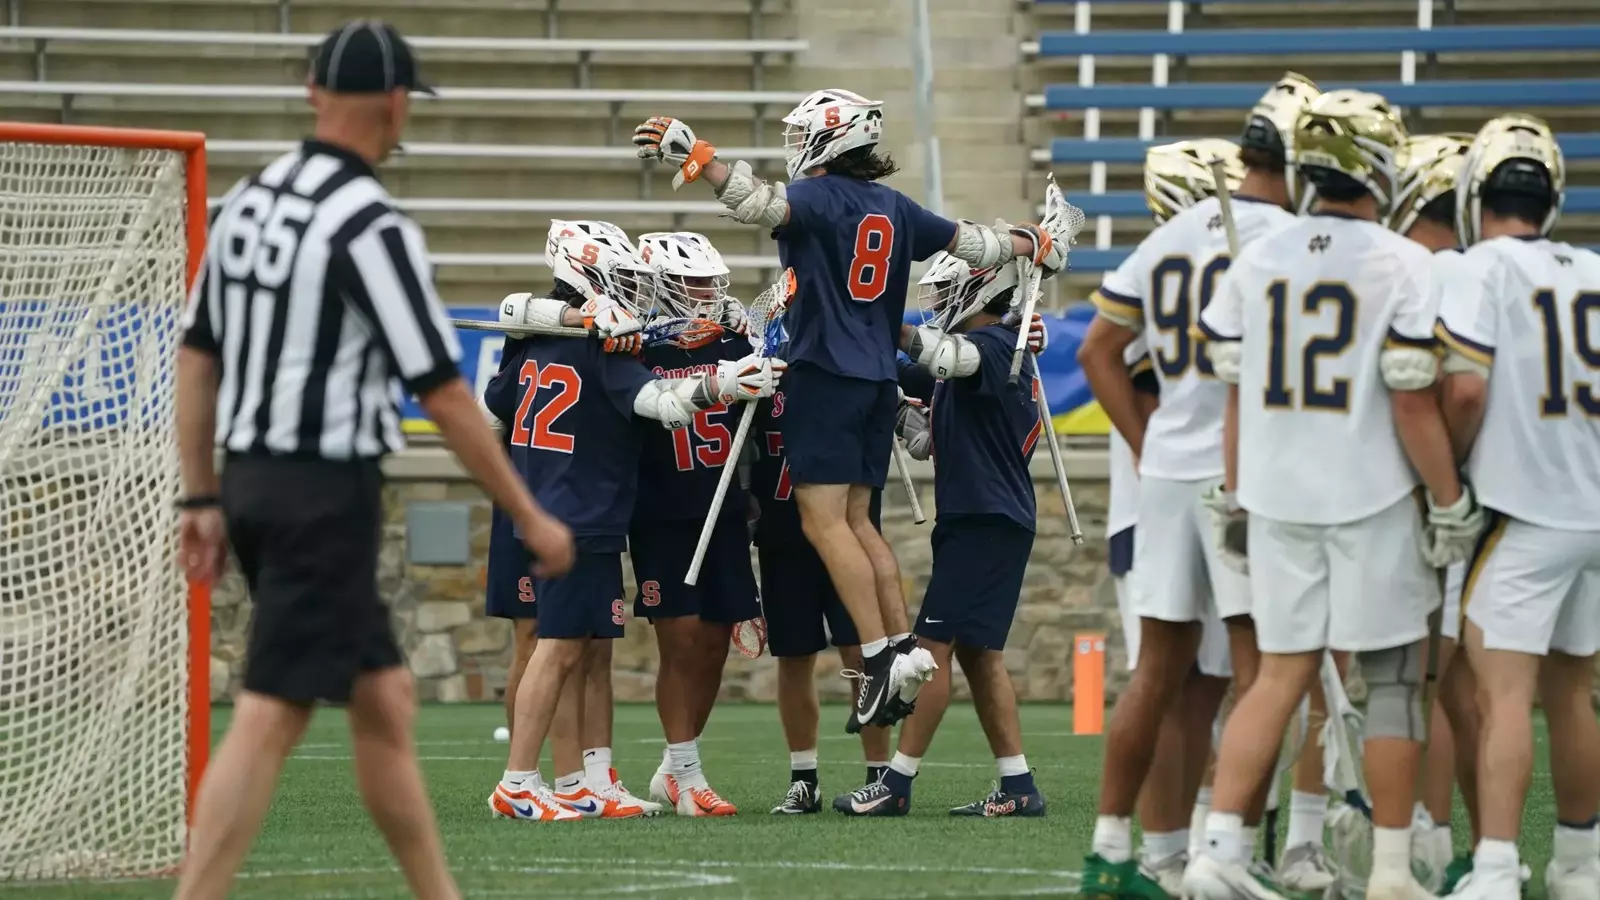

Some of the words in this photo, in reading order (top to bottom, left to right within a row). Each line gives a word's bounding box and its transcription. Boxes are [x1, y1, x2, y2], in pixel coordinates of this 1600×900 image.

[825, 106, 841, 128] S
[221, 186, 316, 289] 65
[581, 243, 600, 265] S
[847, 213, 894, 302] 8
[1264, 279, 1357, 412] 12
[511, 360, 582, 453] 22
[672, 401, 732, 471] 15
[518, 576, 536, 602] S
[612, 599, 625, 625] S
[642, 580, 661, 606] S
